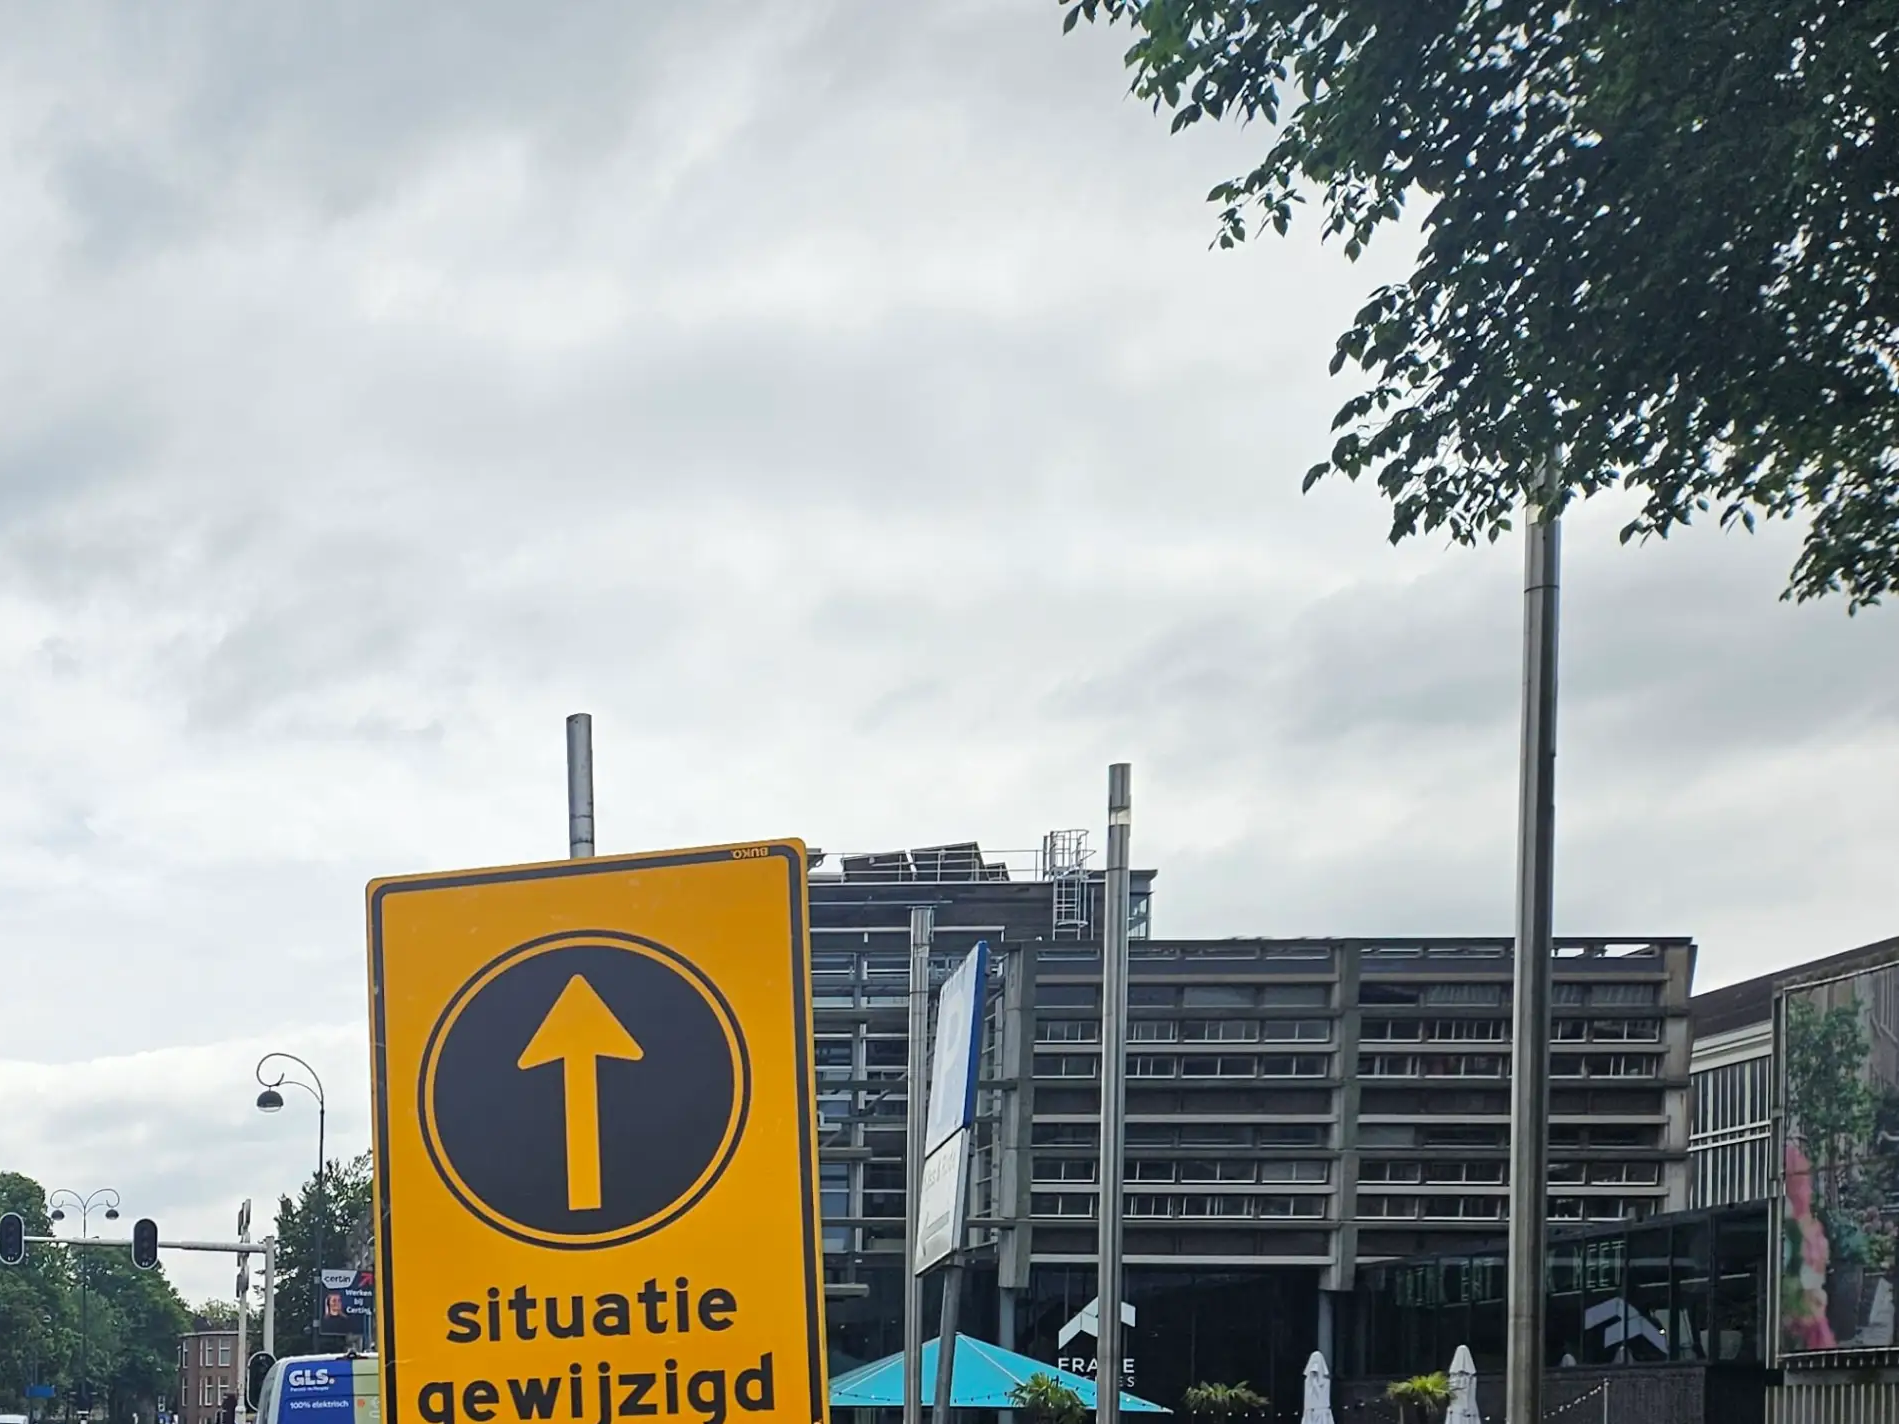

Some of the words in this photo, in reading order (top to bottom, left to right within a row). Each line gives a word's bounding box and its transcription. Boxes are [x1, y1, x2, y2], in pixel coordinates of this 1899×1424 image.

[935, 989, 965, 1125] P
[324, 1275, 351, 1283] certin
[345, 1289, 373, 1297] Werken
[353, 1297, 364, 1306] bij
[446, 1276, 738, 1344] situatie
[1058, 1357, 1136, 1374] FRAE
[289, 1400, 311, 1409] 100%
[312, 1400, 349, 1409] elektrisch
